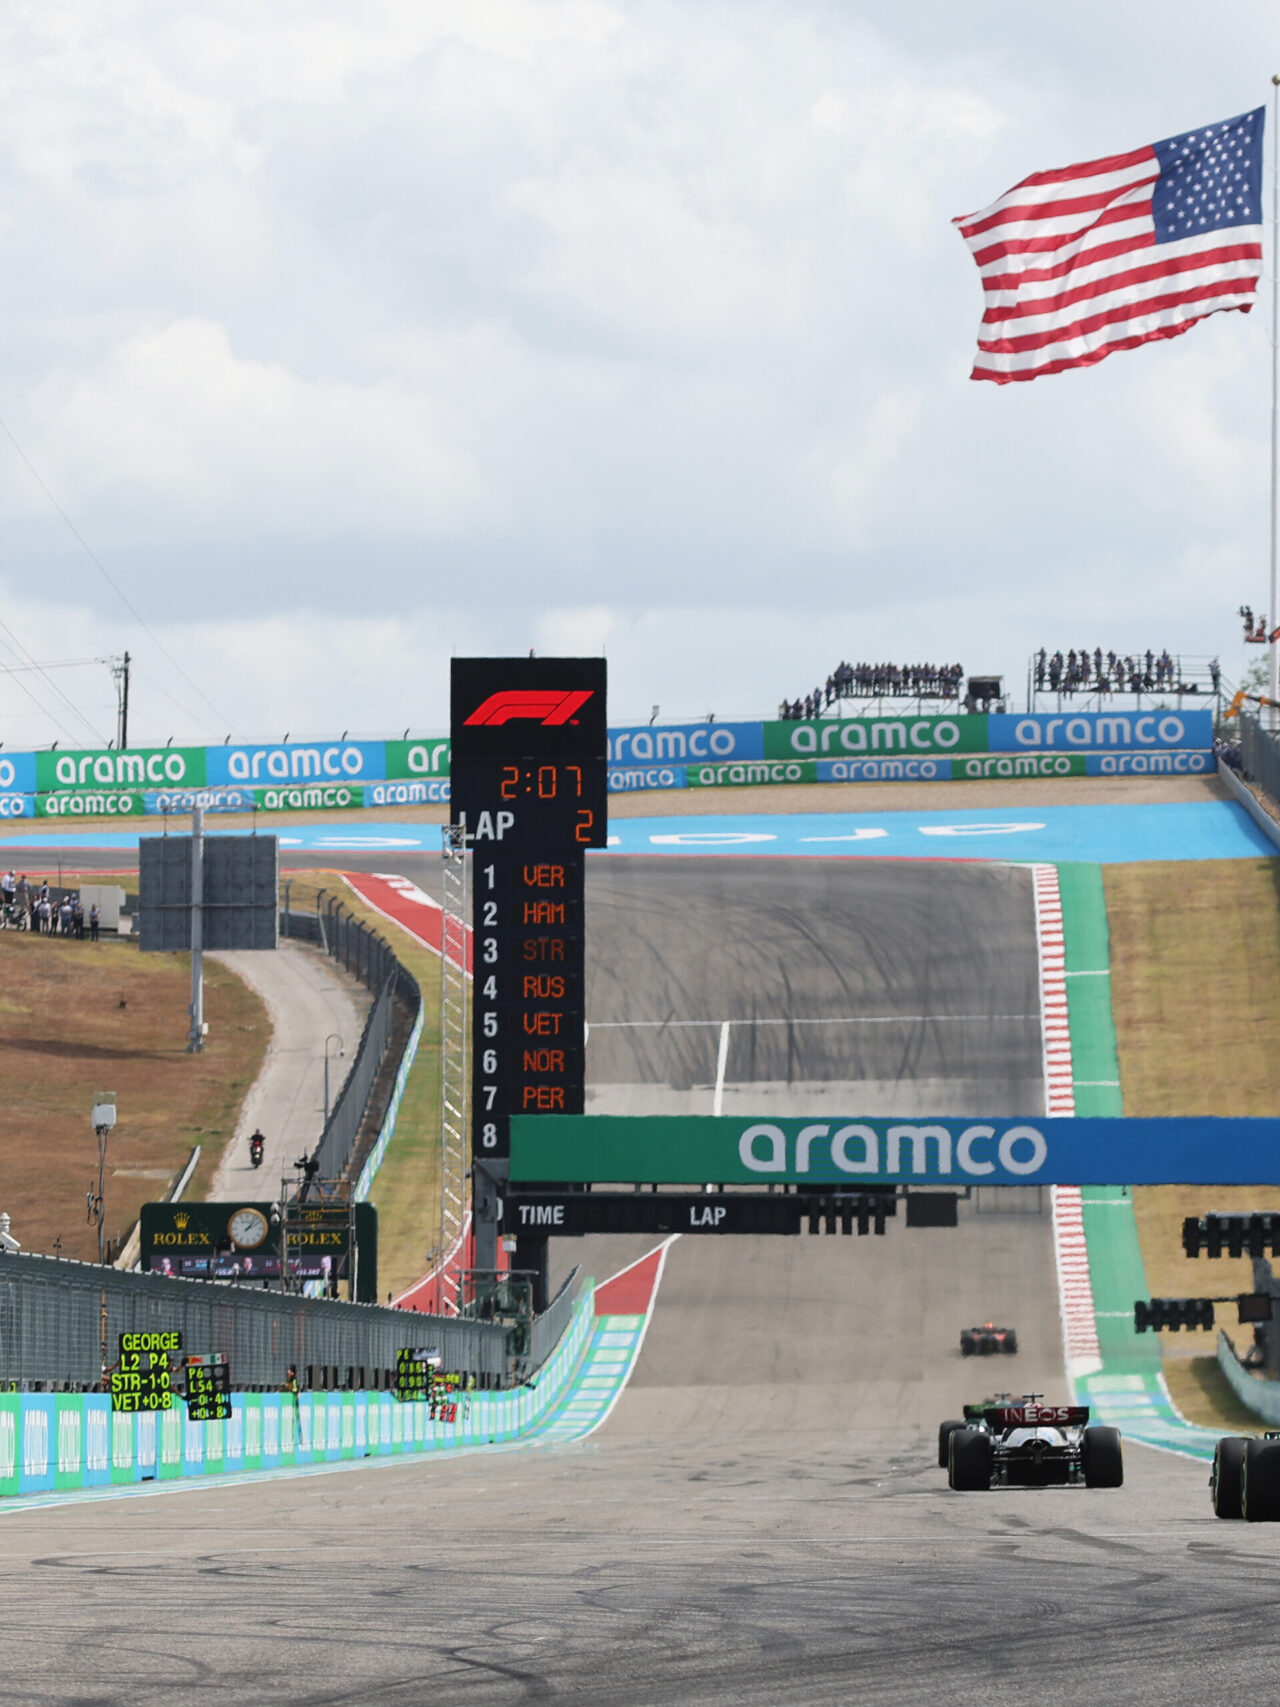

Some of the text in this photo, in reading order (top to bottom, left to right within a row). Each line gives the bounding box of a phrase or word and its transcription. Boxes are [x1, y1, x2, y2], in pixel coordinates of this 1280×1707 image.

[791, 720, 961, 753] aramco
[1015, 716, 1185, 746] aramco
[607, 729, 736, 761] ramco
[56, 753, 187, 785] aramco
[228, 747, 364, 779] aramco
[699, 764, 802, 785] aramco
[831, 761, 937, 780] aramco
[965, 757, 1071, 777] aramco
[1100, 753, 1206, 774] aramco
[501, 766, 582, 798] 2:07
[607, 768, 675, 789] amco
[45, 795, 133, 815] aramco
[264, 788, 351, 809] aramco
[459, 810, 515, 841] LAP
[575, 809, 594, 842] 2
[483, 865, 565, 890] 1 VER
[483, 902, 565, 926] 2 HAM
[483, 938, 565, 964] 3 STR
[483, 975, 565, 1000] 4 RUS
[483, 1012, 562, 1038] 5 VET
[483, 1049, 565, 1075] 6 NOR
[483, 1086, 565, 1111] 7 PER
[482, 1123, 498, 1148] 8
[738, 1124, 1047, 1175] aramco
[518, 1205, 565, 1225] TIME
[690, 1206, 727, 1226] LAP
[153, 1232, 211, 1246] ROLEX
[286, 1232, 343, 1246] ROLEX
[122, 1332, 179, 1351] GEORGE
[121, 1352, 169, 1371] L2 P4
[1004, 1407, 1069, 1422] INEOS
